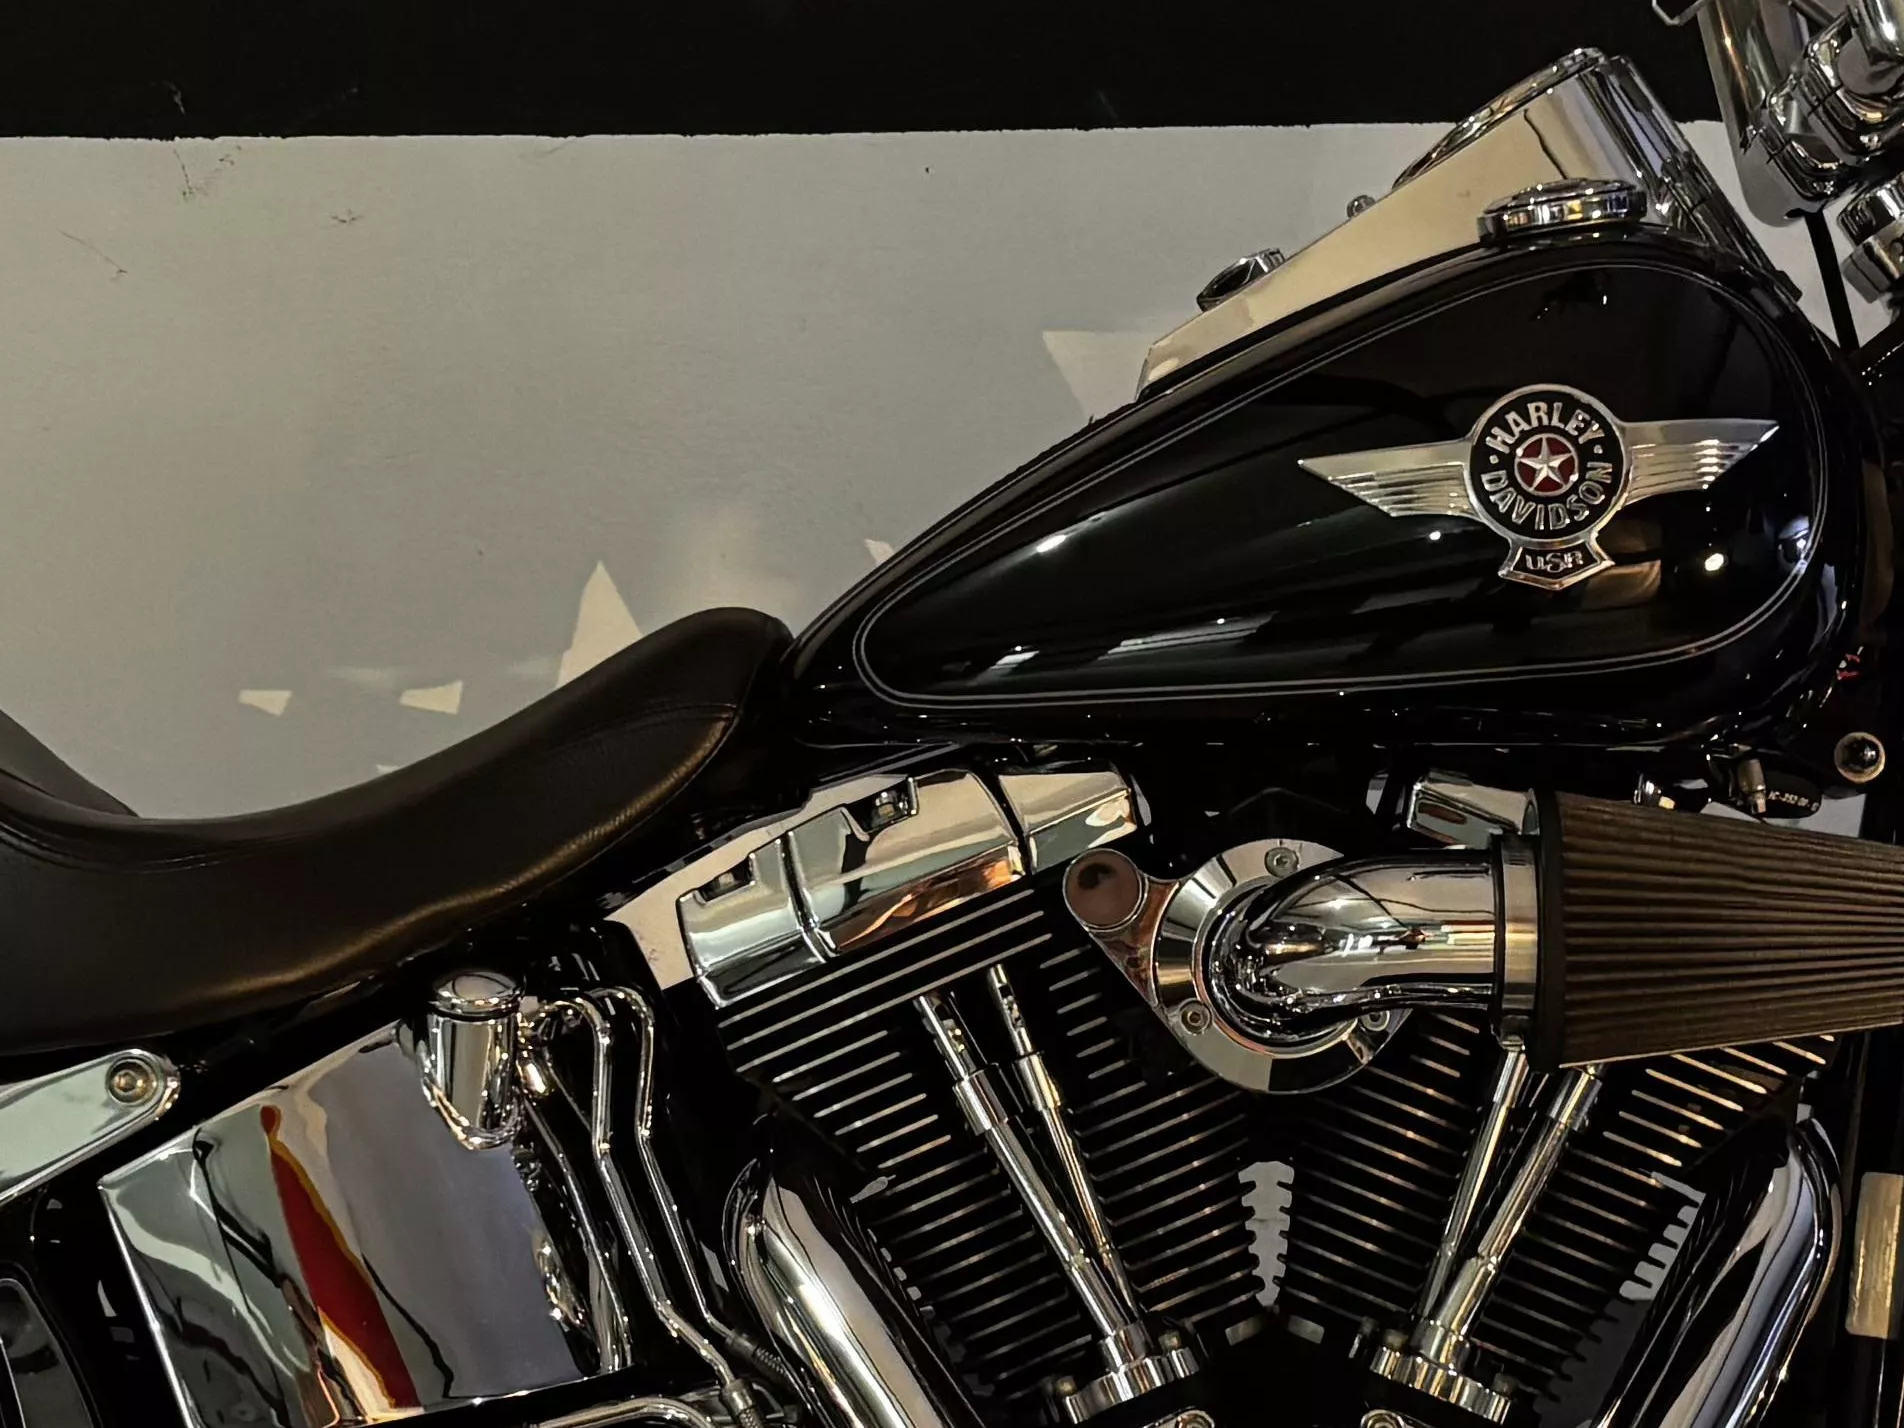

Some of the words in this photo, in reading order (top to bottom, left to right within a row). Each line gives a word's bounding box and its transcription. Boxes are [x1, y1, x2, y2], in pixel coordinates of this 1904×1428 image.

[1485, 400, 1605, 454] HARLEY
[1480, 461, 1613, 530] DAVIDSON
[1524, 550, 1585, 574] USA
